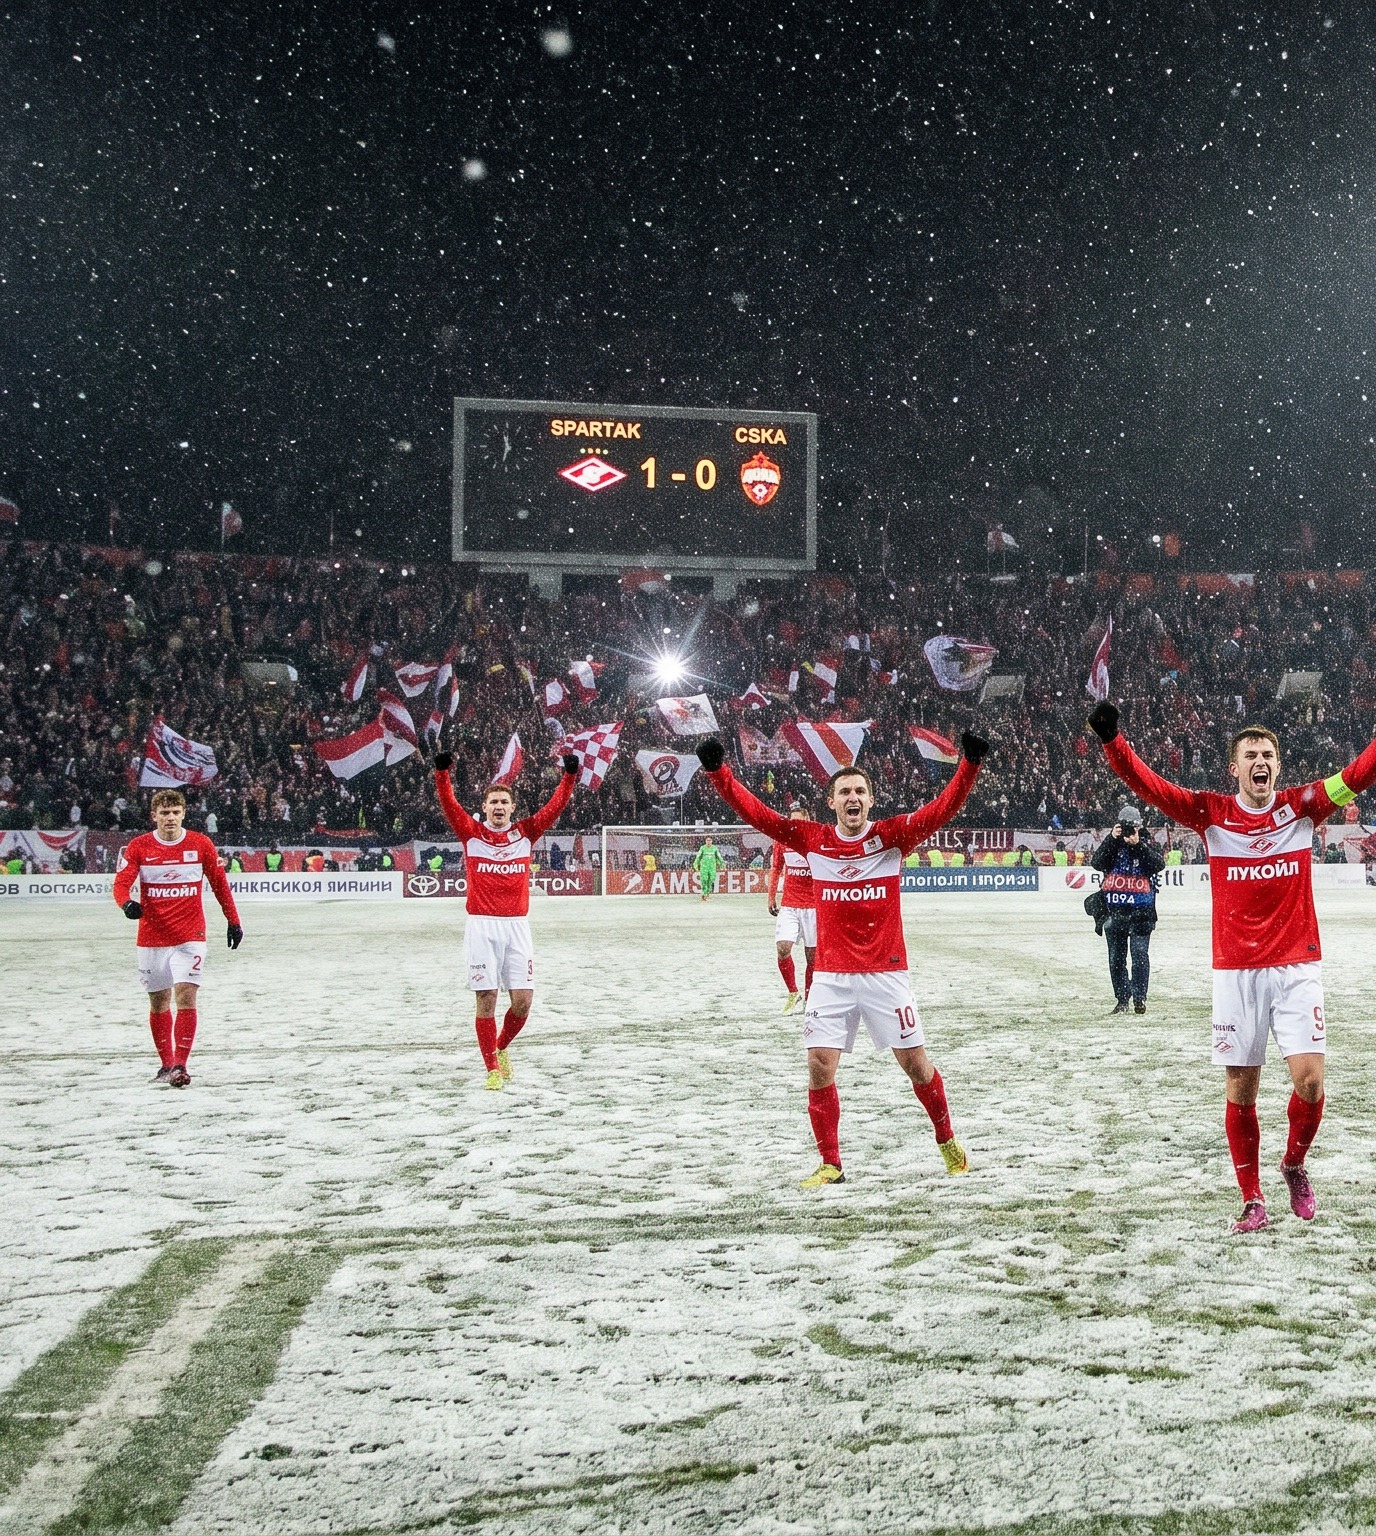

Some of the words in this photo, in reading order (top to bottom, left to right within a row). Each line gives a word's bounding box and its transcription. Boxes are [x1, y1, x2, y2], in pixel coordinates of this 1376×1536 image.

[550, 419, 642, 440] SPARTAK
[735, 427, 788, 445] CSKA
[640, 457, 656, 489] 1
[695, 459, 717, 491] 0
[1227, 859, 1300, 881] ЛУКОЙЛ
[822, 884, 887, 902] ЛУКОЙЛ
[192, 955, 202, 971] 2
[894, 1005, 916, 1031] 10
[1313, 1006, 1325, 1031] 9
